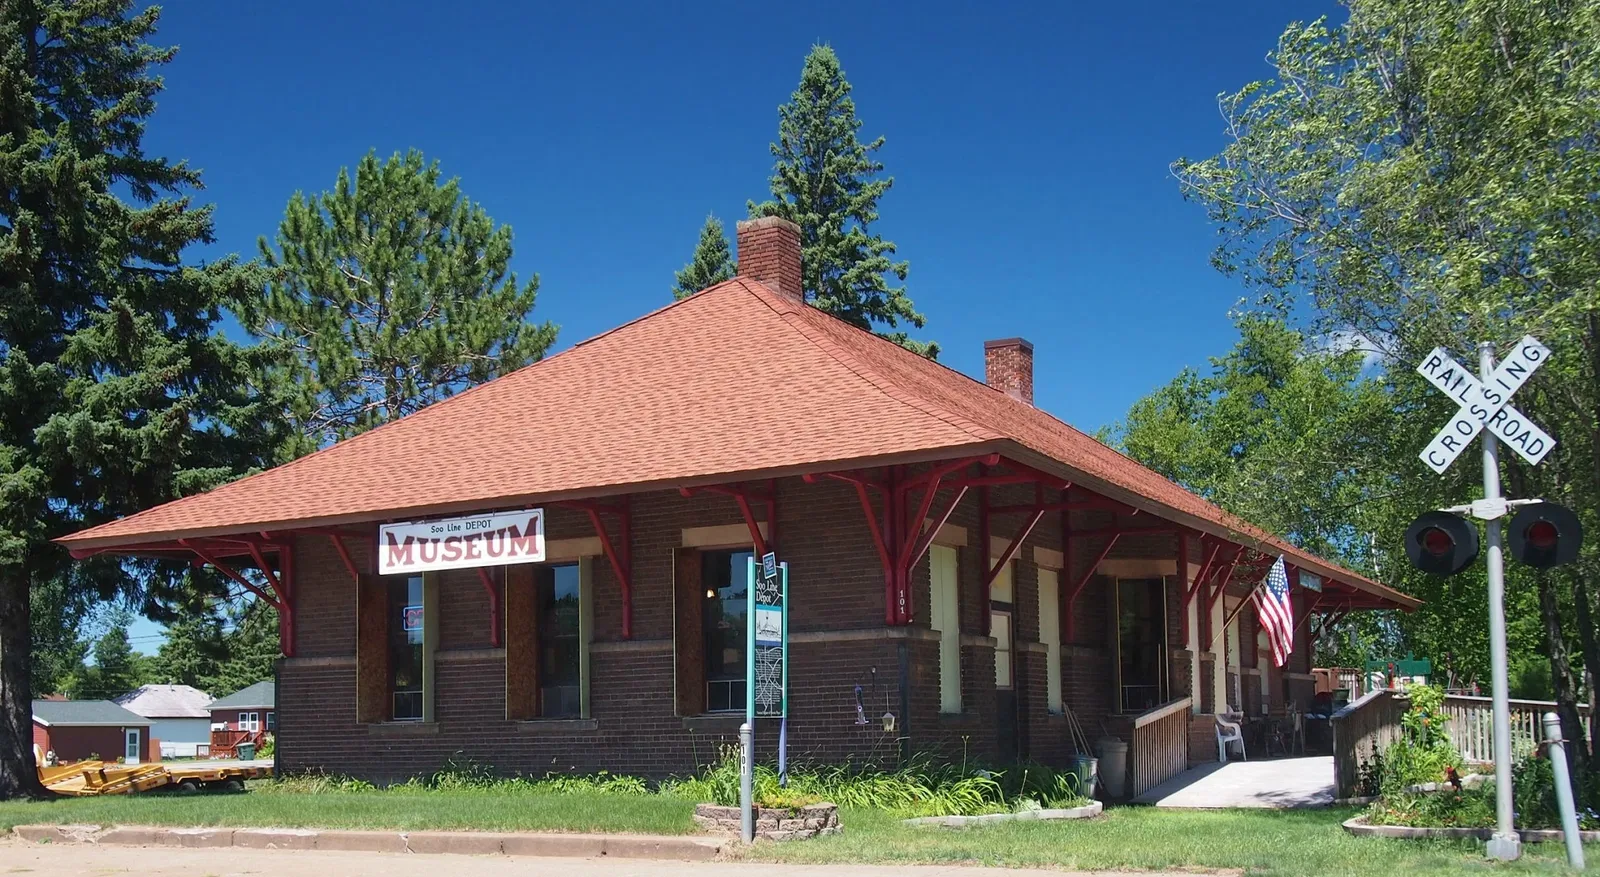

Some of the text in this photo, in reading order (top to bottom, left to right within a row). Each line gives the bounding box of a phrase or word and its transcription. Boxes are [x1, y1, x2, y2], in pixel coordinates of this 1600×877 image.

[1429, 345, 1541, 467] CROSSING
[431, 520, 492, 534] Soo Line DEPOT
[386, 515, 539, 567] MUSEUM
[756, 579, 766, 590] Soo
[756, 591, 772, 604] Depot
